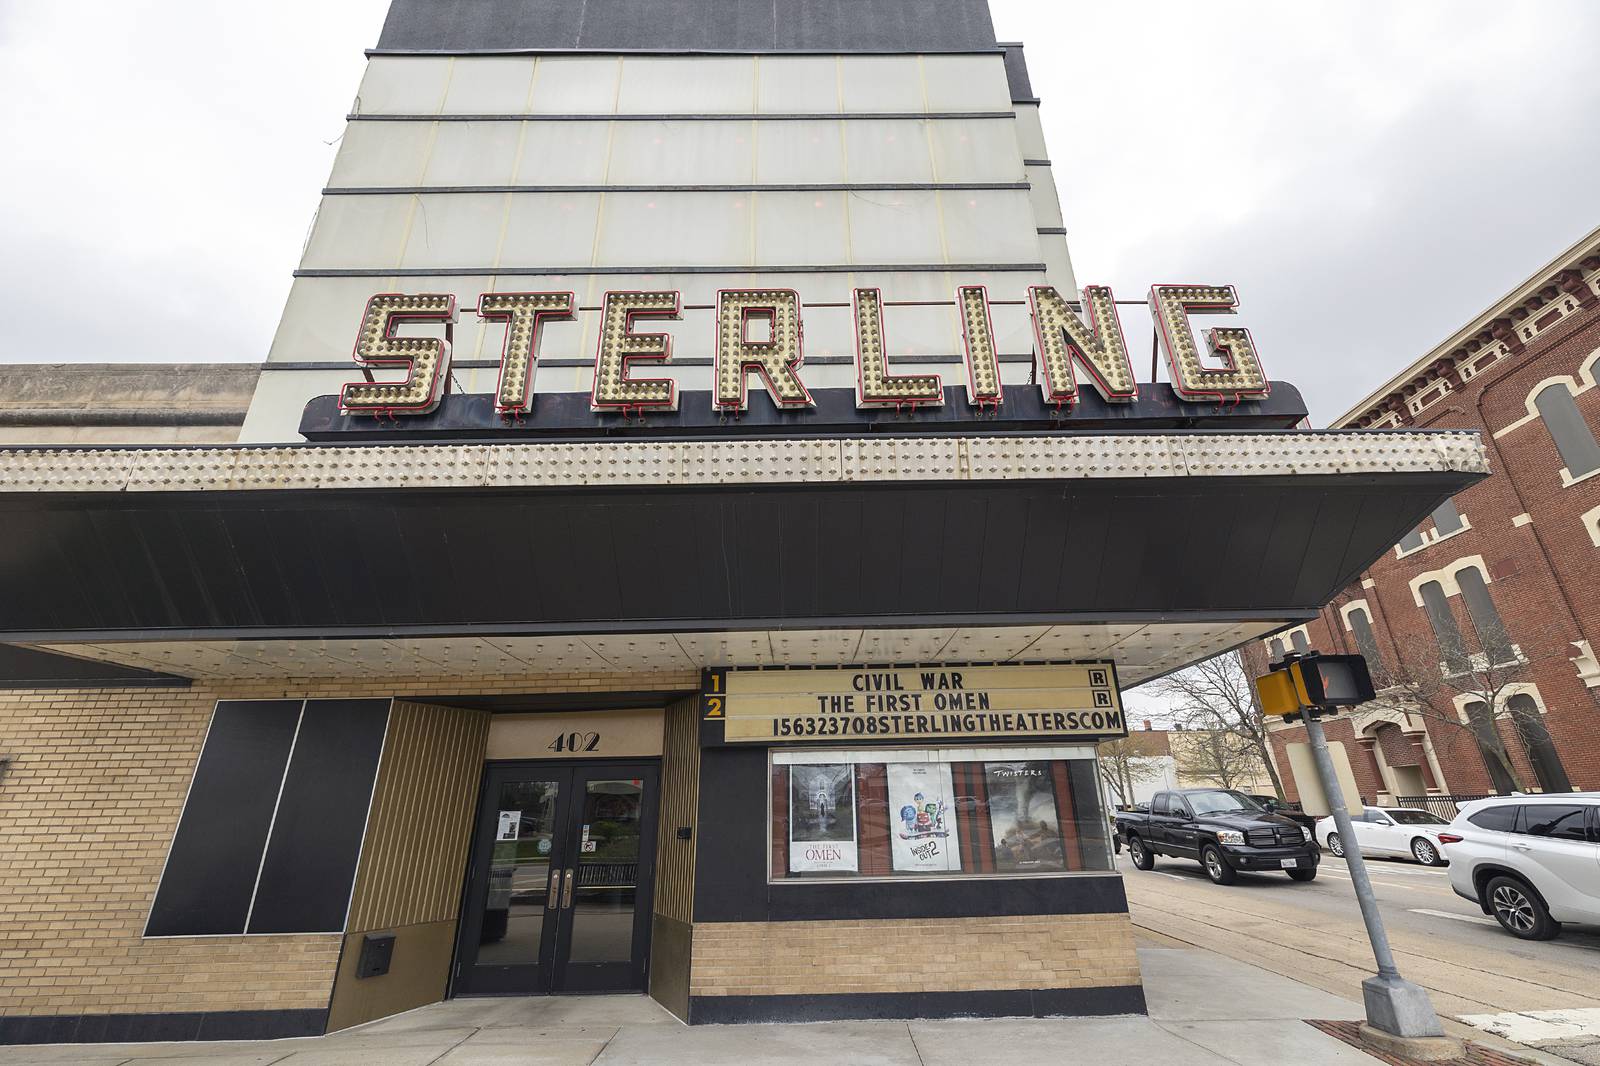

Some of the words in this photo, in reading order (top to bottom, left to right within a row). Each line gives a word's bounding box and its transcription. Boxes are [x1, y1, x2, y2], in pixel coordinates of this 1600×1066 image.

[339, 284, 1271, 414] STERLING
[711, 674, 720, 692] 1
[852, 673, 904, 691] CIVIL
[920, 672, 964, 690] WAR
[707, 698, 721, 716] 2
[818, 695, 855, 713] THE
[866, 694, 922, 712] FIRST
[934, 692, 990, 710] OMEN
[547, 731, 600, 752] 402
[993, 769, 1042, 777] TWISTERS
[805, 849, 841, 861] OMEN
[919, 850, 932, 861] OUT
[928, 841, 940, 856] 2
